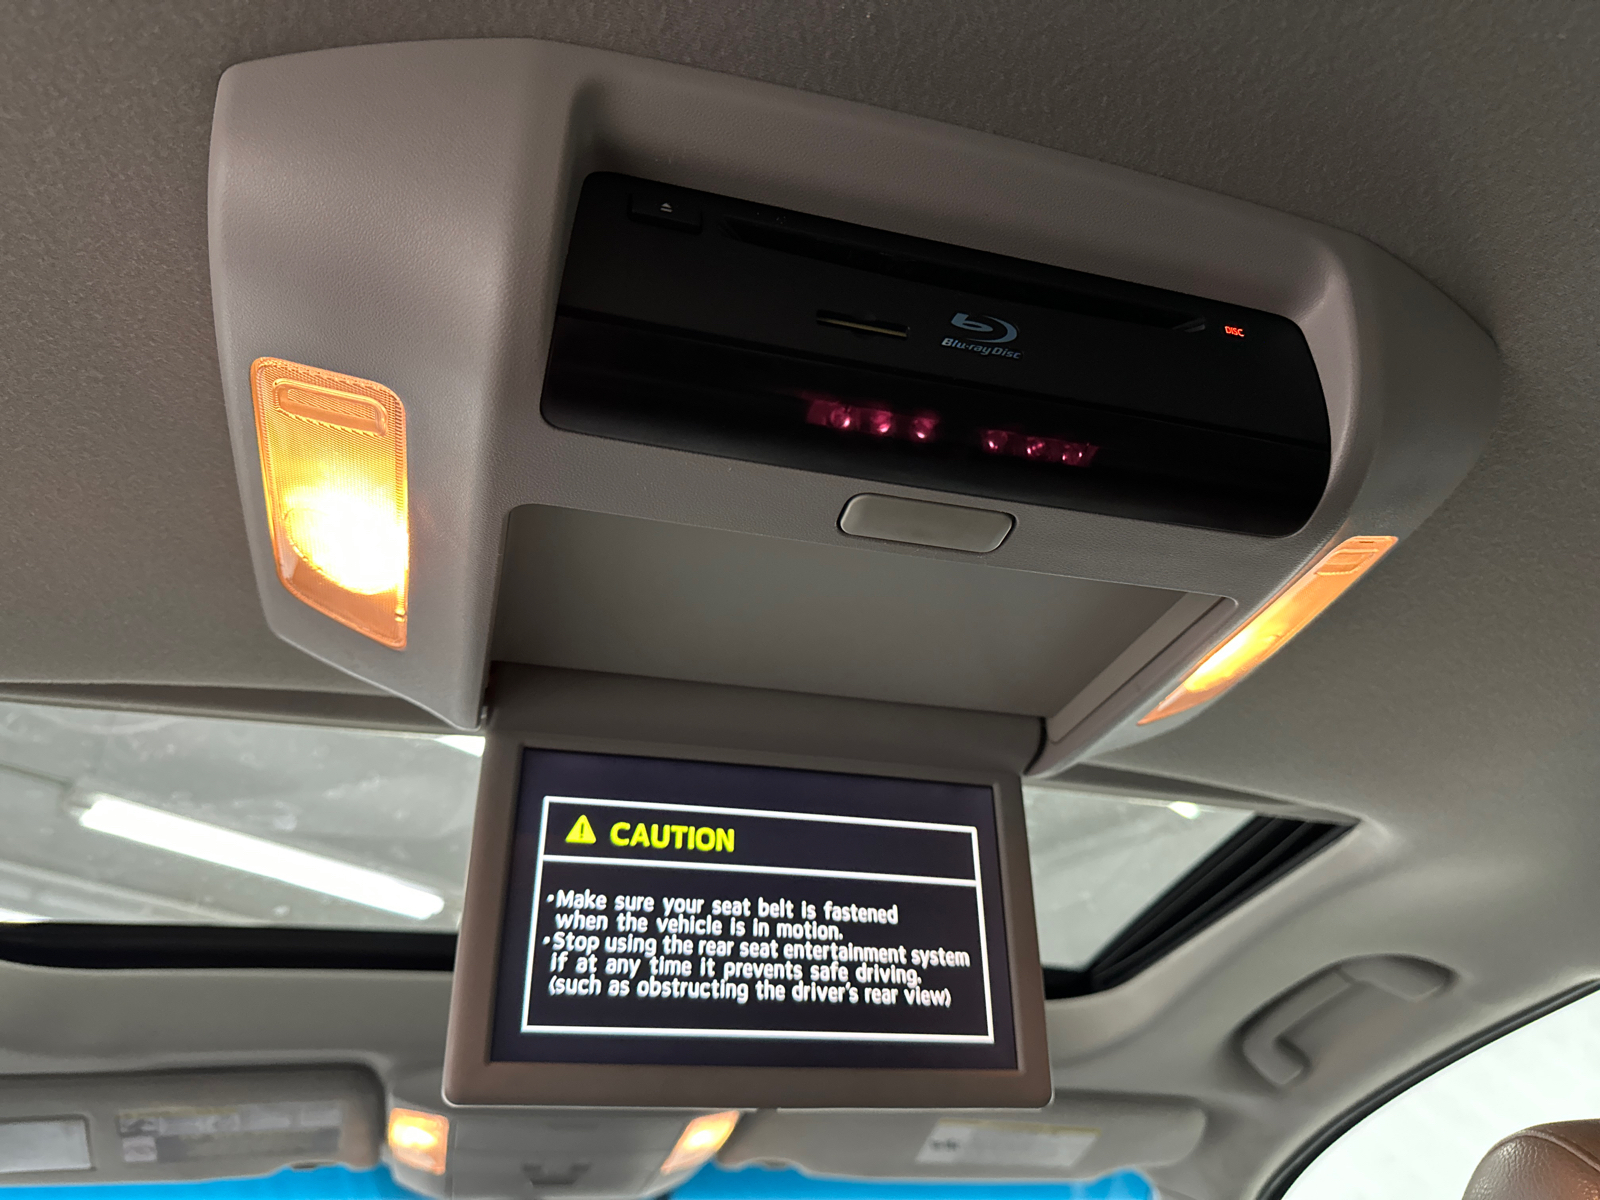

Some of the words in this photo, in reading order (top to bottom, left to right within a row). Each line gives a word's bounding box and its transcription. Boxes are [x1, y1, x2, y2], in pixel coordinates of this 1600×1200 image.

[1225, 326, 1245, 337] DISC
[992, 346, 1021, 359] Disc
[610, 821, 735, 852] CAUTION
[556, 890, 607, 910] Make
[614, 894, 654, 912] sure
[662, 898, 704, 916] your
[712, 899, 750, 917] seat
[758, 898, 793, 919] belt
[801, 901, 816, 921] is
[823, 901, 898, 925] fastened
[556, 912, 608, 932] when
[616, 913, 648, 932] the
[656, 916, 722, 935] vehicle
[730, 918, 746, 937] is
[753, 918, 769, 937] in
[776, 920, 843, 940] motion.
[552, 932, 599, 954] Stop
[605, 935, 656, 957] using
[664, 934, 692, 955] the
[698, 940, 734, 957] rear
[739, 939, 778, 959] seat
[783, 942, 907, 964] entertainment
[911, 948, 970, 969] system
[550, 954, 568, 972] if
[576, 955, 597, 974] at
[605, 958, 640, 978] any
[649, 956, 692, 976] time
[700, 958, 716, 977] it
[723, 960, 802, 982] prevents
[810, 960, 848, 981] safe
[855, 961, 922, 988] driving.
[548, 975, 601, 996] (such
[608, 979, 629, 996] as
[637, 978, 748, 1004] obstructing
[755, 981, 785, 1000] the
[791, 981, 858, 1003] driver's
[865, 986, 897, 1003] rear
[904, 986, 951, 1008] view)
